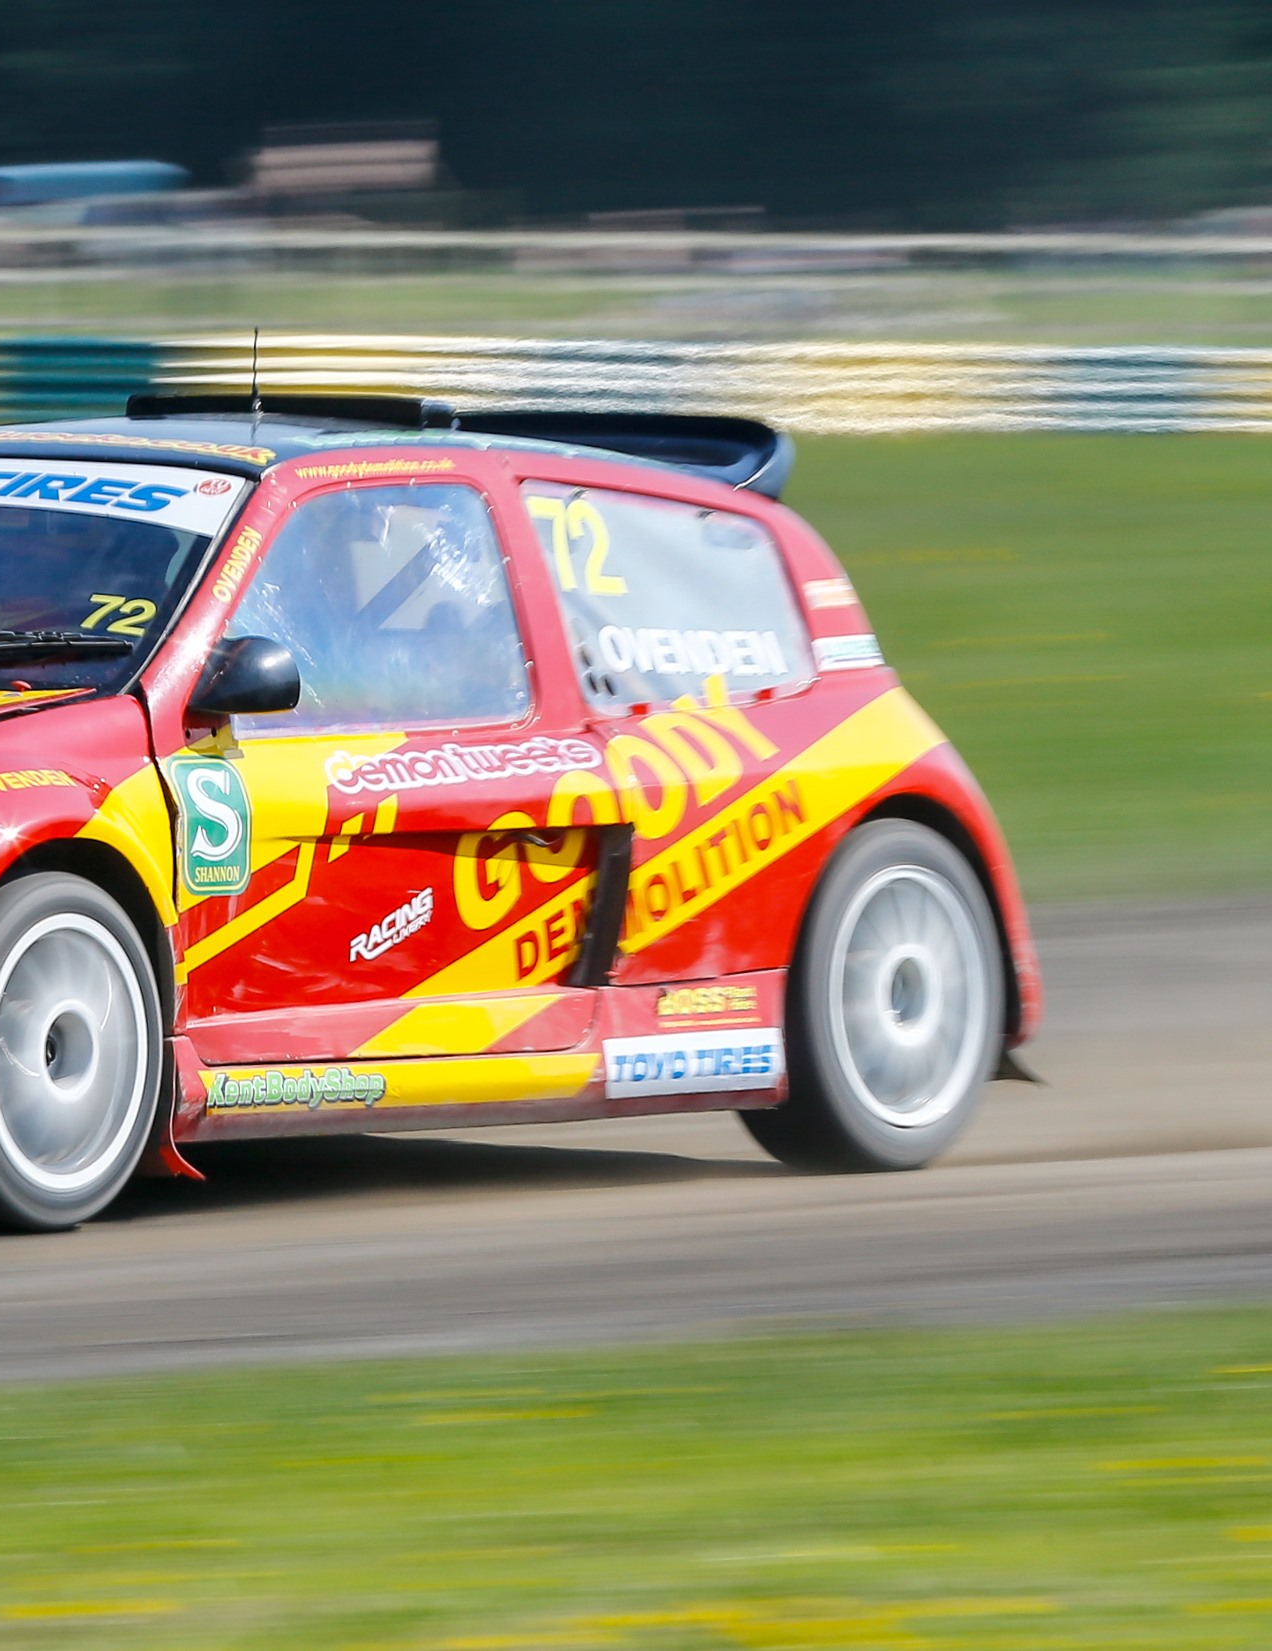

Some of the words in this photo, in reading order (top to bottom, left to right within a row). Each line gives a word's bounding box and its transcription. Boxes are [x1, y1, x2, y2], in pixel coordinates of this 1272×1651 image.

[212, 525, 263, 603] OVENDEN
[525, 495, 629, 596] 72
[79, 593, 157, 637] 72
[598, 624, 789, 676] OVENDEN
[186, 767, 243, 862] S
[453, 673, 781, 931] GOODY
[194, 865, 241, 883] SHANNON
[349, 886, 434, 962] RACING
[206, 1067, 387, 1111] KentBodyShop
[609, 1050, 688, 1083] TOYO
[693, 1044, 773, 1077] TIRES
